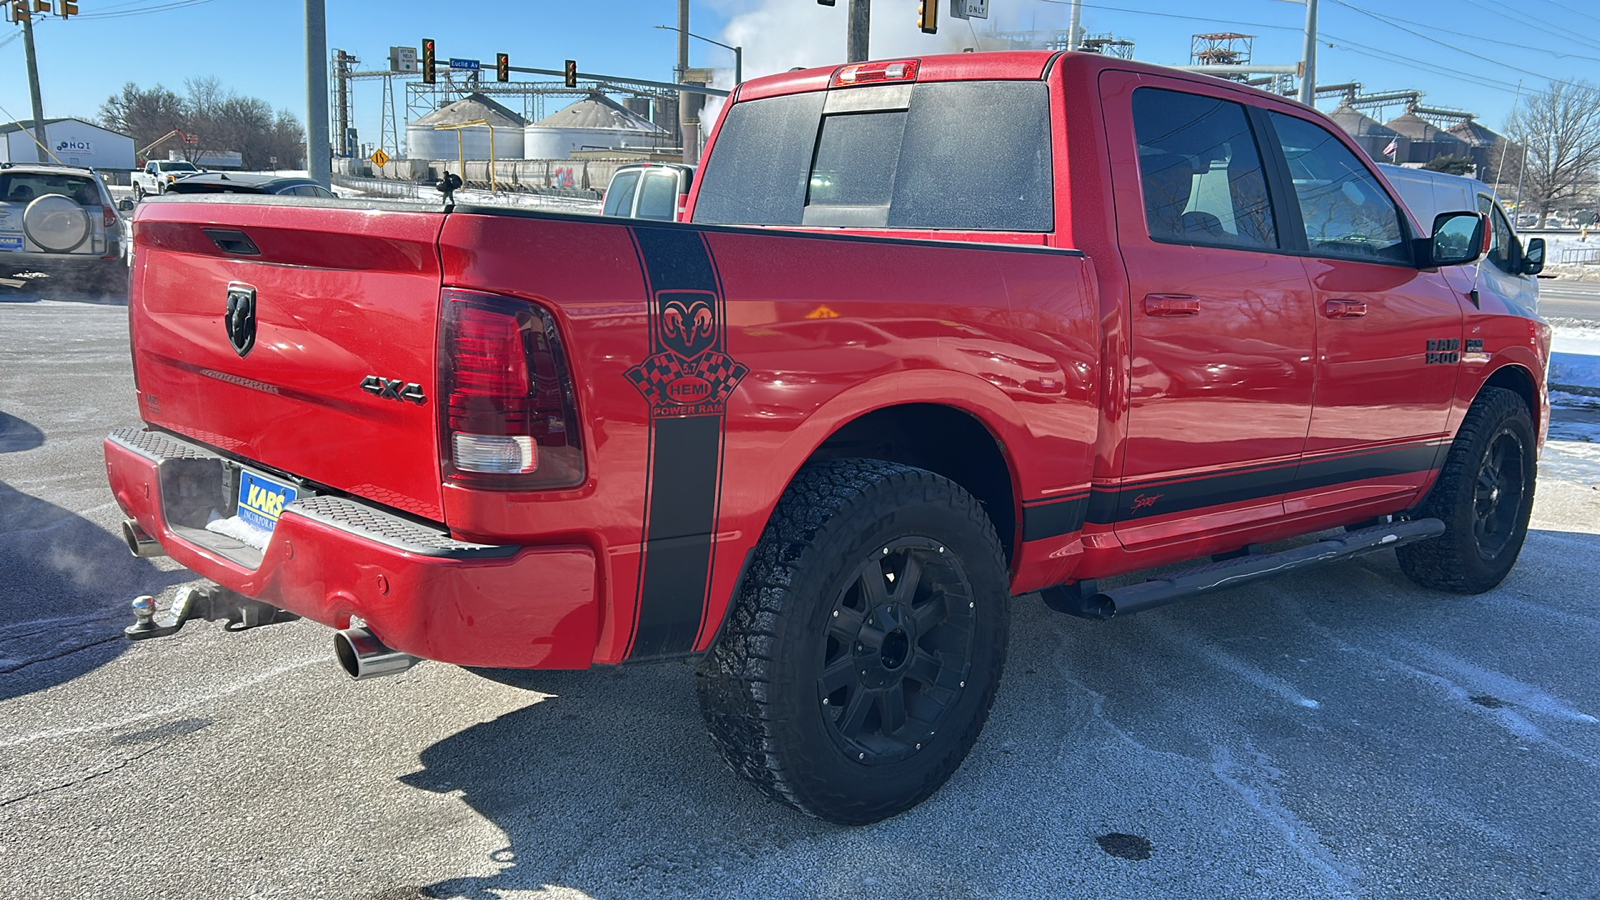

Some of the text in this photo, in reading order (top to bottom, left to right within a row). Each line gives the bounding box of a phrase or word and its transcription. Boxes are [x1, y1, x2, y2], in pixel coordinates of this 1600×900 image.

[968, 5, 985, 14] ONLY
[69, 141, 91, 150] HQI
[1426, 338, 1460, 351] RAM
[1426, 351, 1460, 365] 1500
[683, 363, 697, 373] 5.7
[670, 383, 709, 396] HEMI
[653, 403, 724, 416] POWER RAM
[247, 483, 285, 517] KARS
[1130, 493, 1165, 515] Sport
[243, 509, 277, 529] INCORPORAT
